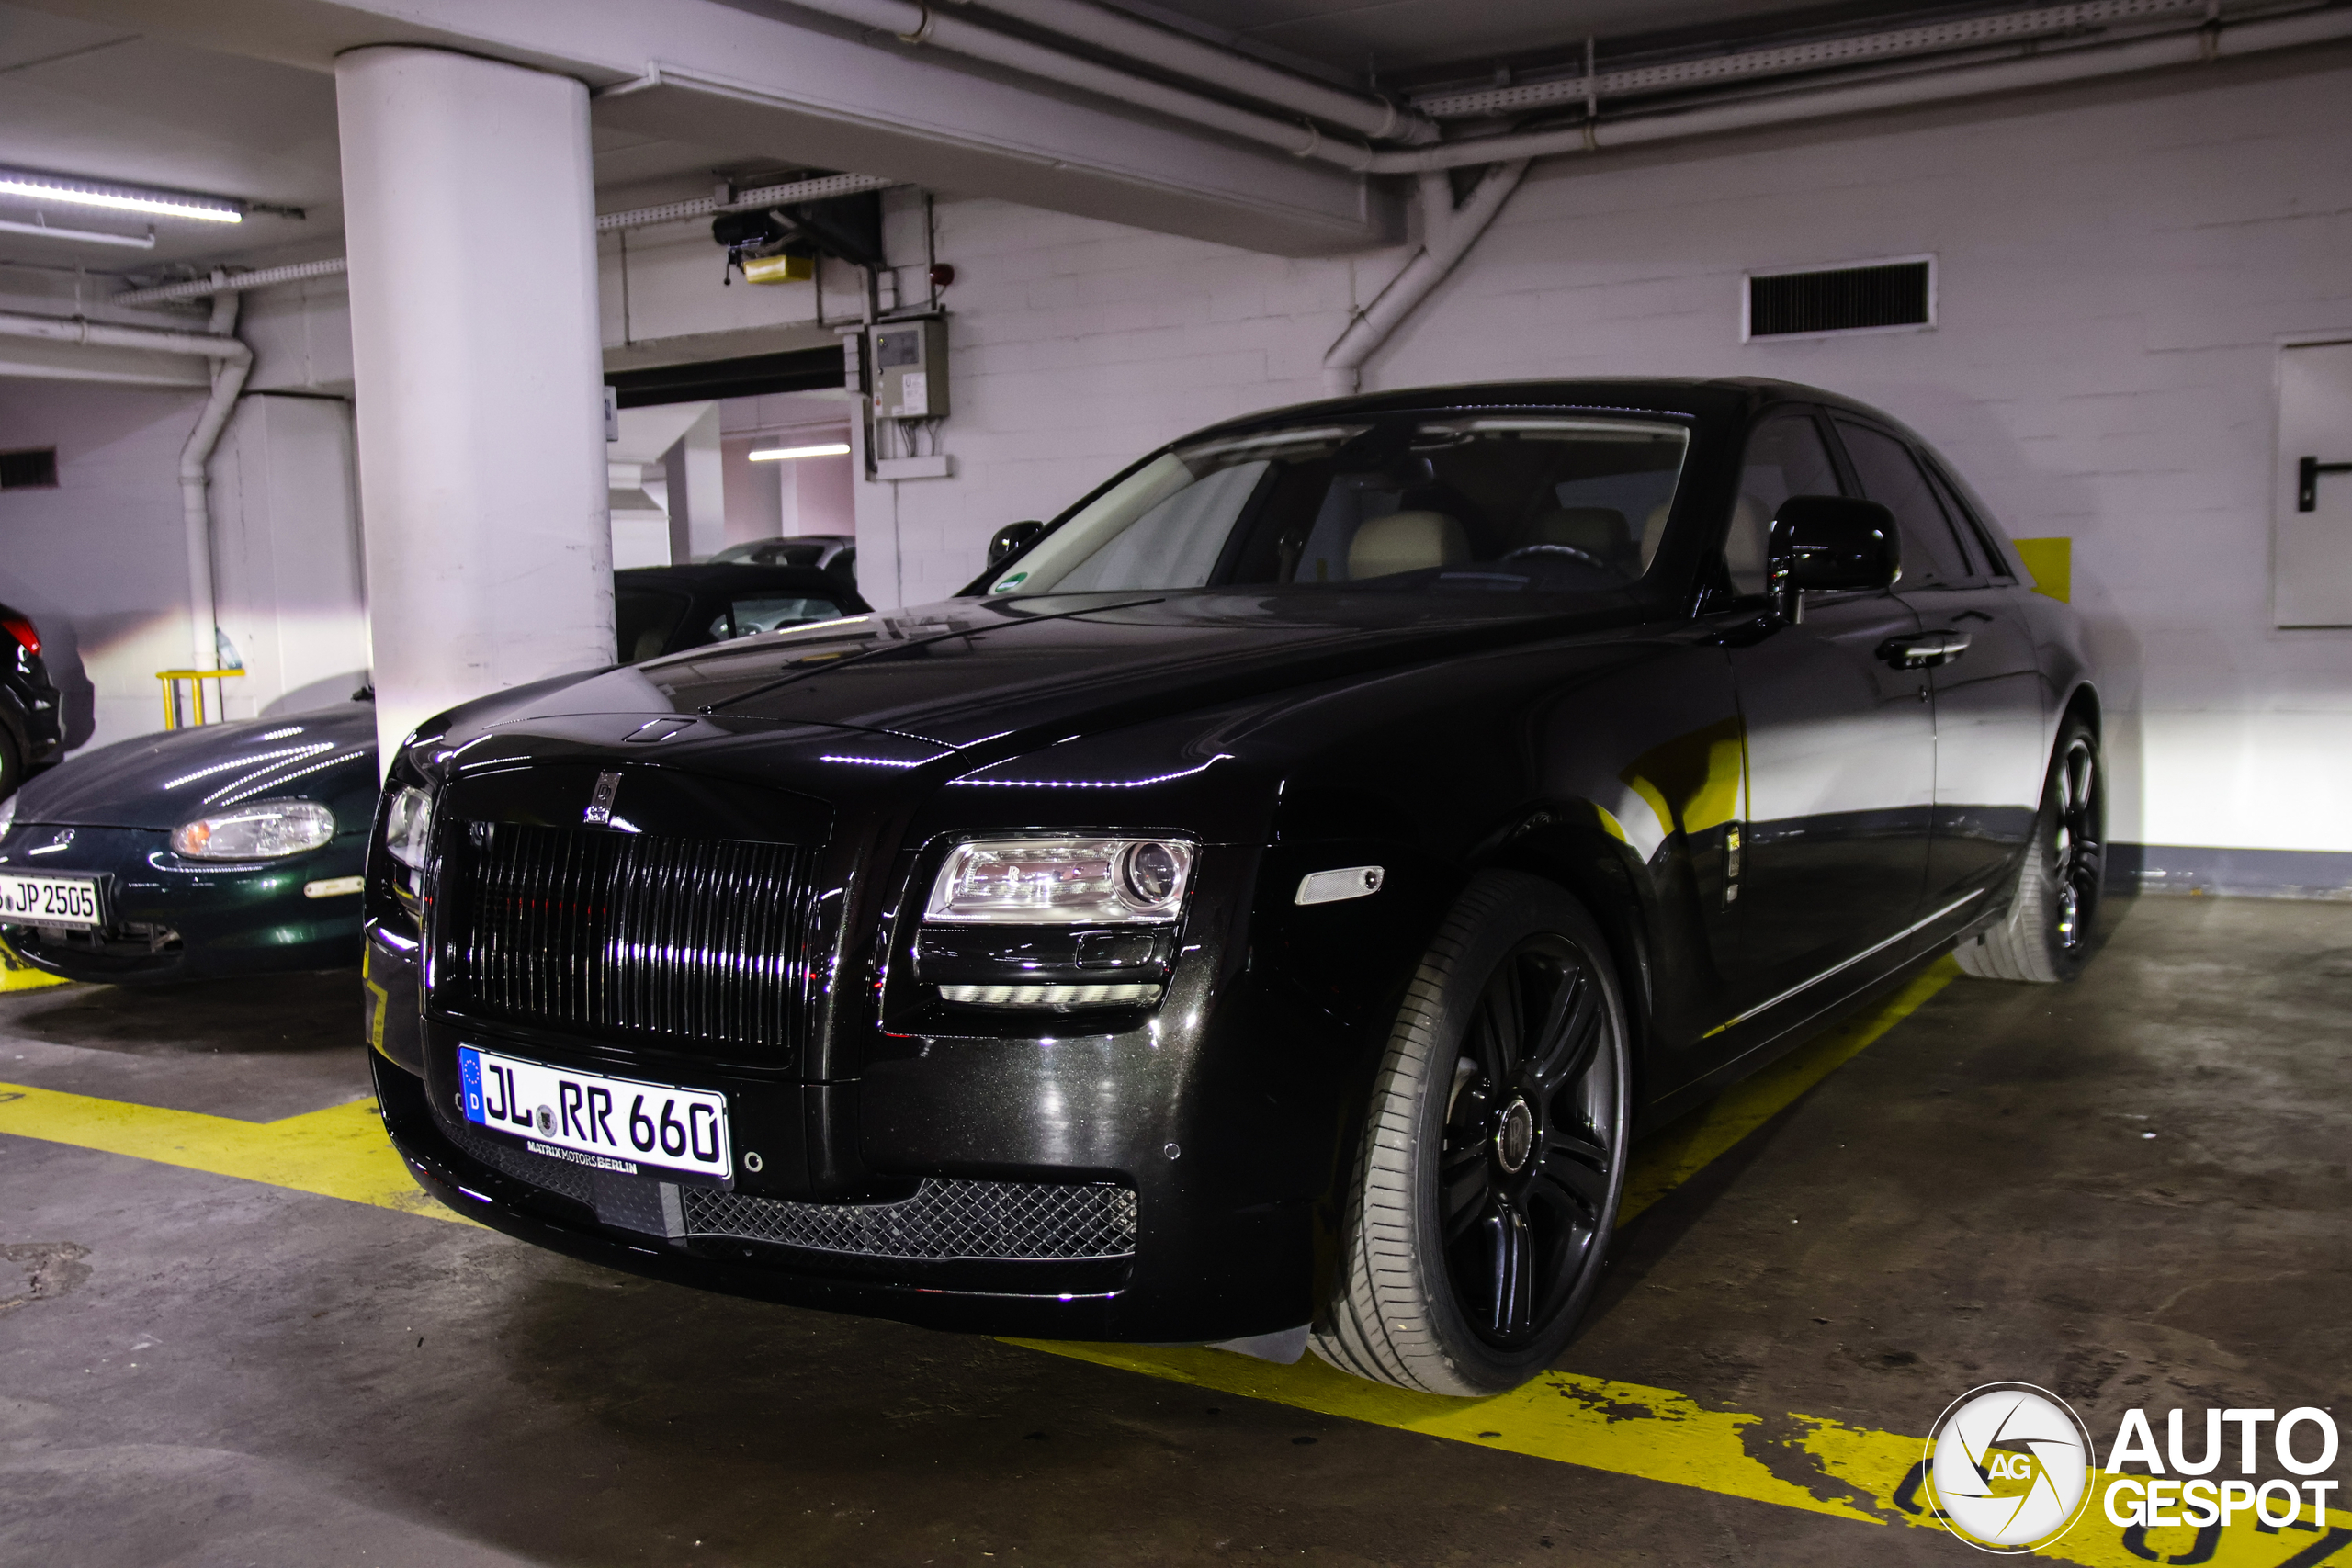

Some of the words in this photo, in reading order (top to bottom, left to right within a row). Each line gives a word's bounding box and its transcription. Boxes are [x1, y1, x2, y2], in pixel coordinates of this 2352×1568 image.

[17, 883, 39, 912] JP
[44, 885, 94, 917] 2505
[470, 1093, 480, 1111] D
[486, 1065, 533, 1128] JL
[559, 1080, 617, 1147] RR
[629, 1094, 720, 1164] 660
